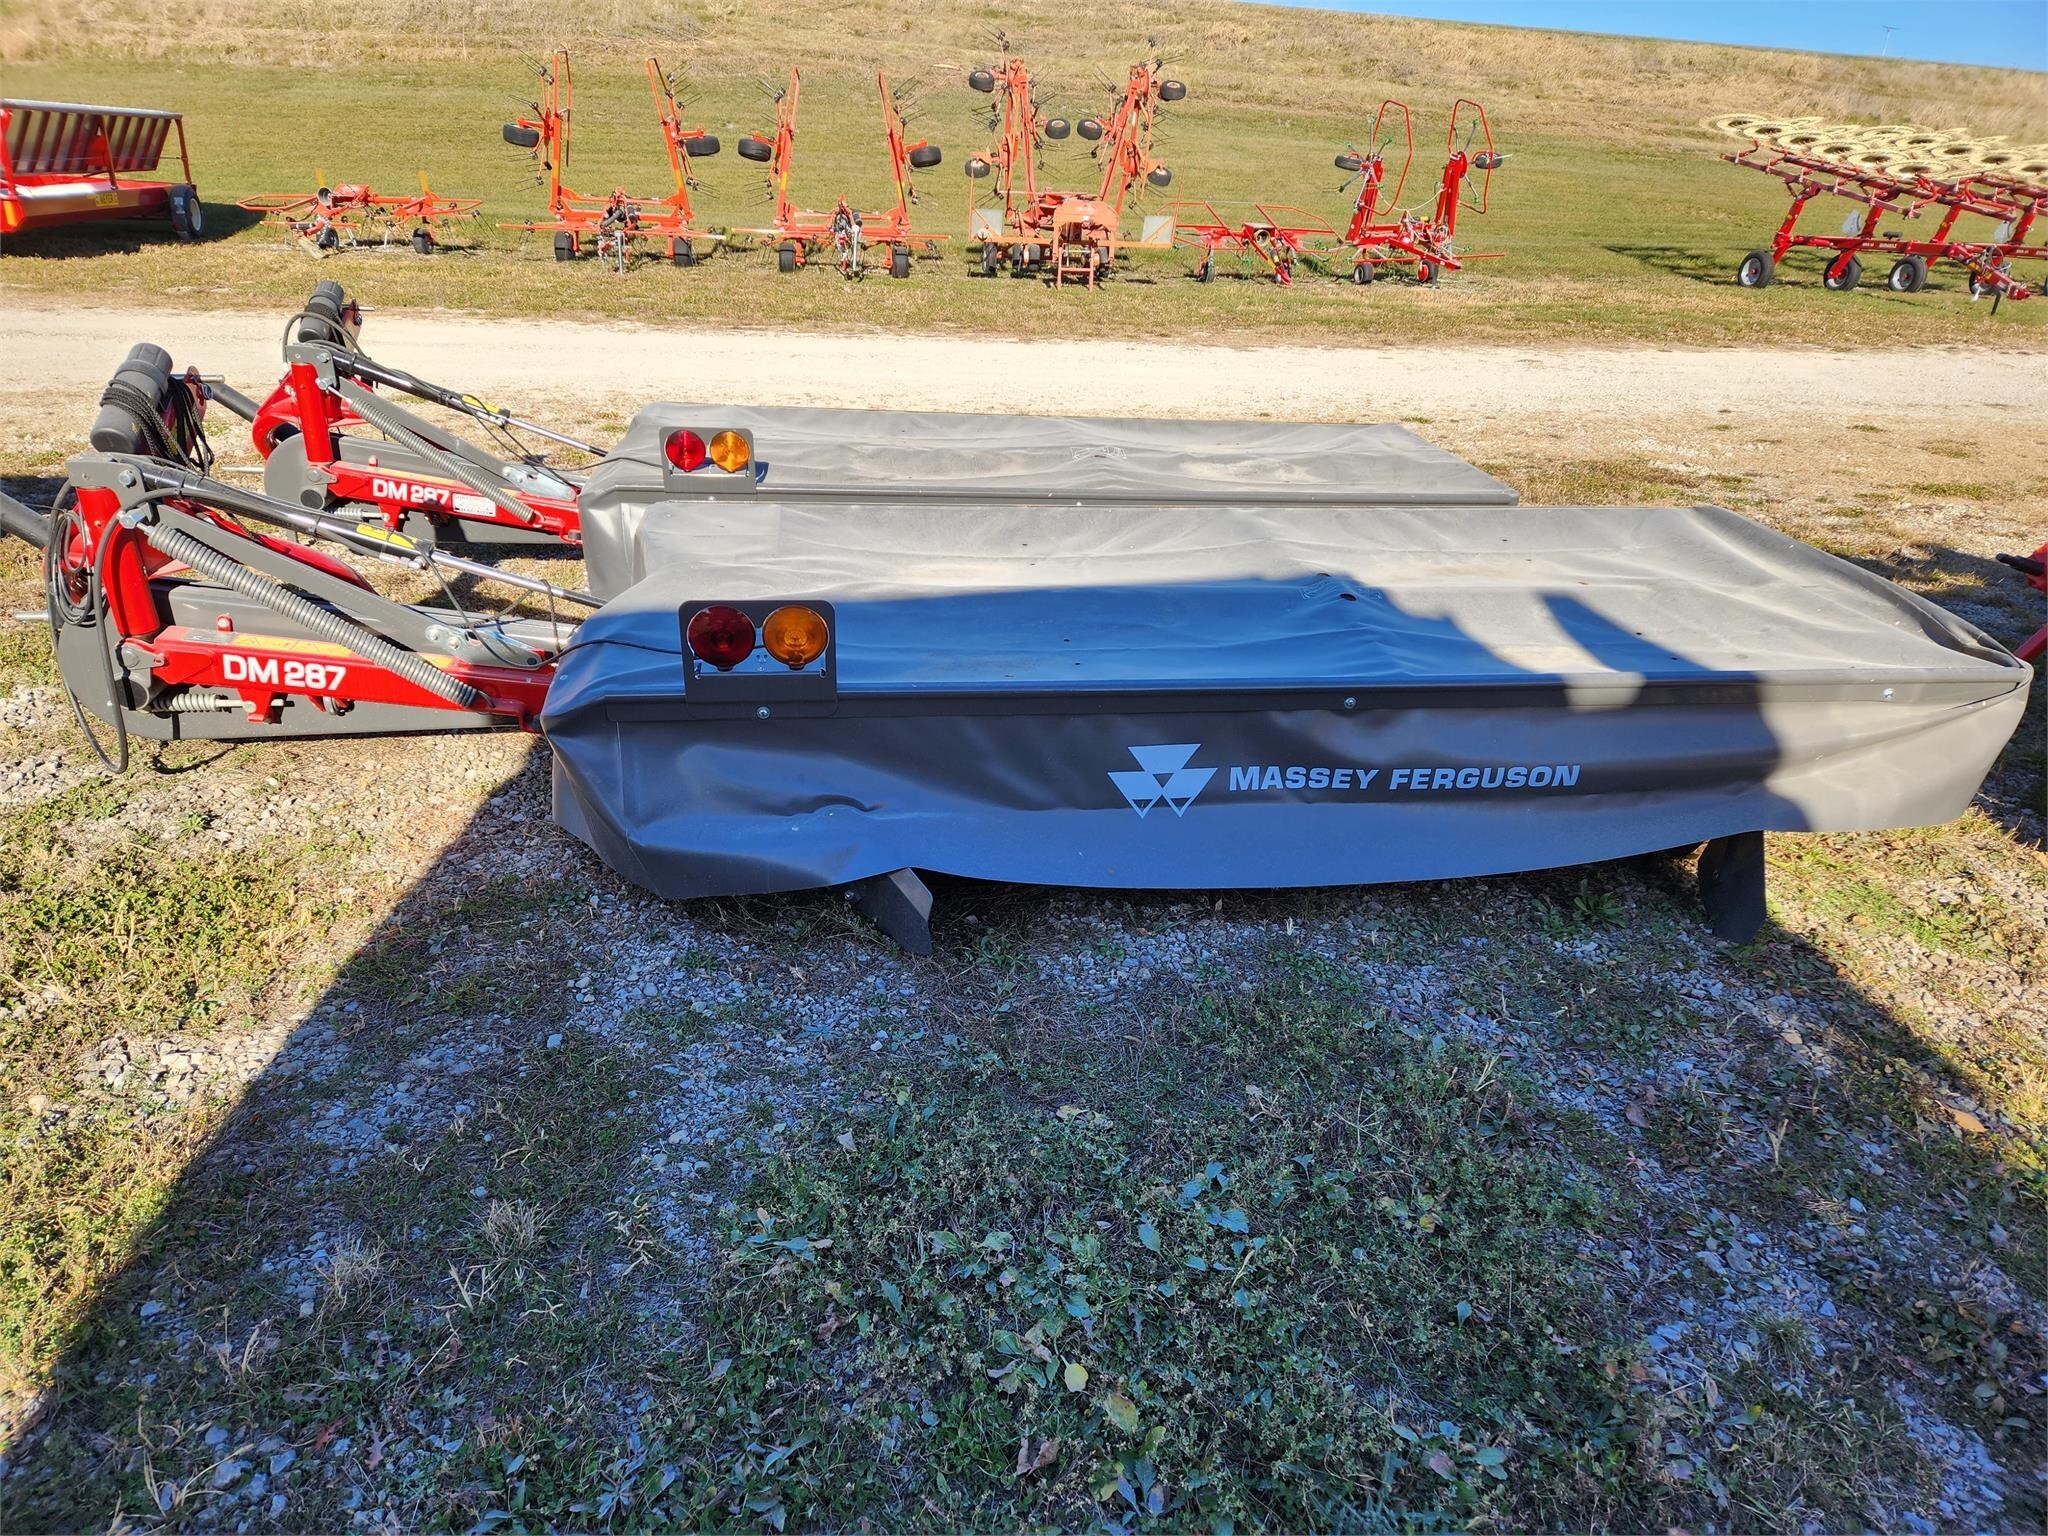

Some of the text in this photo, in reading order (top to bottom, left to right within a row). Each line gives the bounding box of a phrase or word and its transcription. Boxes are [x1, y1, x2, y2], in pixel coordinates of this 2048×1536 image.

[372, 478, 408, 501] DM
[410, 484, 450, 505] 287
[222, 653, 347, 691] DM 287
[1229, 764, 1582, 791] MASSEY FERGUSON
